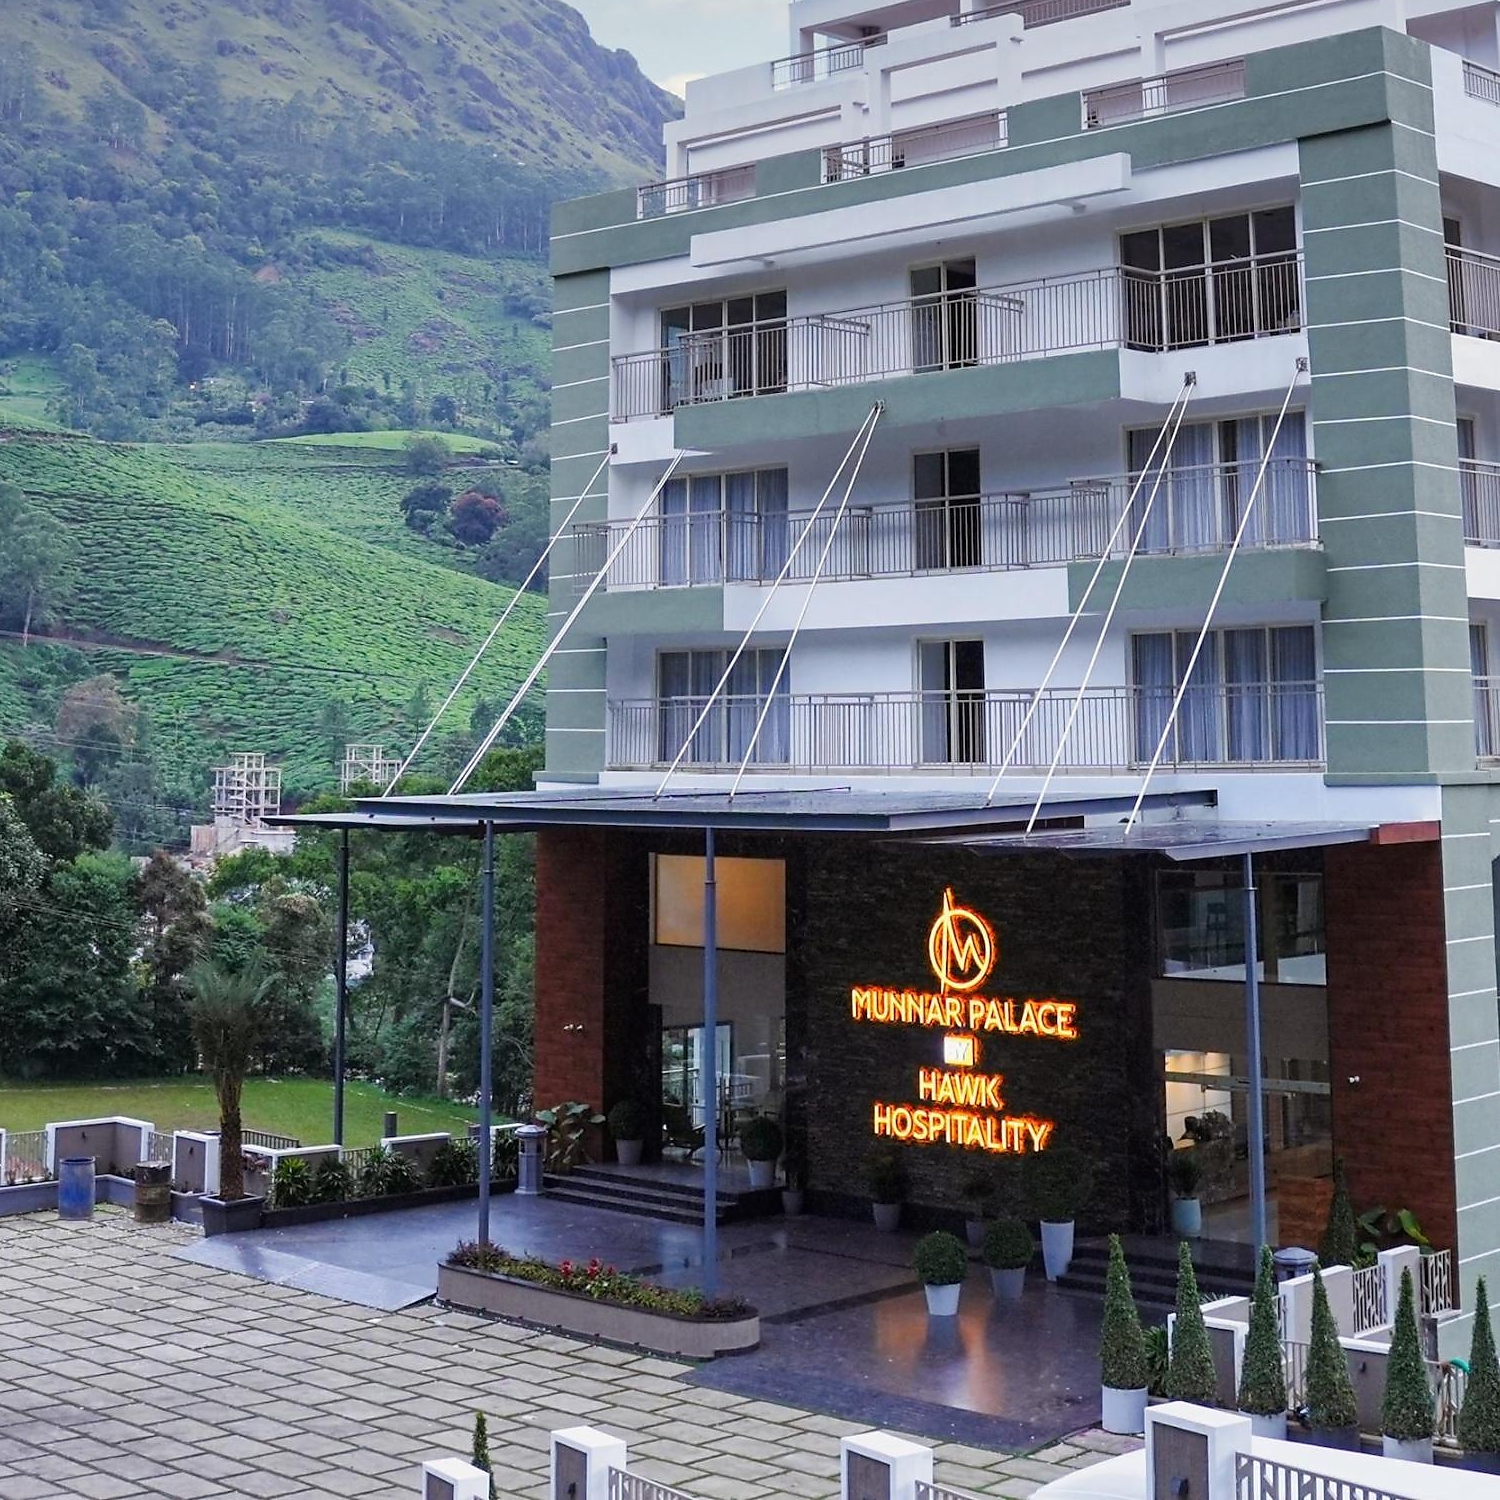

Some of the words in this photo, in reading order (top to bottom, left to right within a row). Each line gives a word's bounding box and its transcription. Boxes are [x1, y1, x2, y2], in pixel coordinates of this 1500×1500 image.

[851, 988, 964, 1028] MUNNAR
[969, 998, 1077, 1038] PALACE
[919, 1070, 1000, 1108] HAWK
[873, 1104, 1049, 1152] HOSPITALITY
